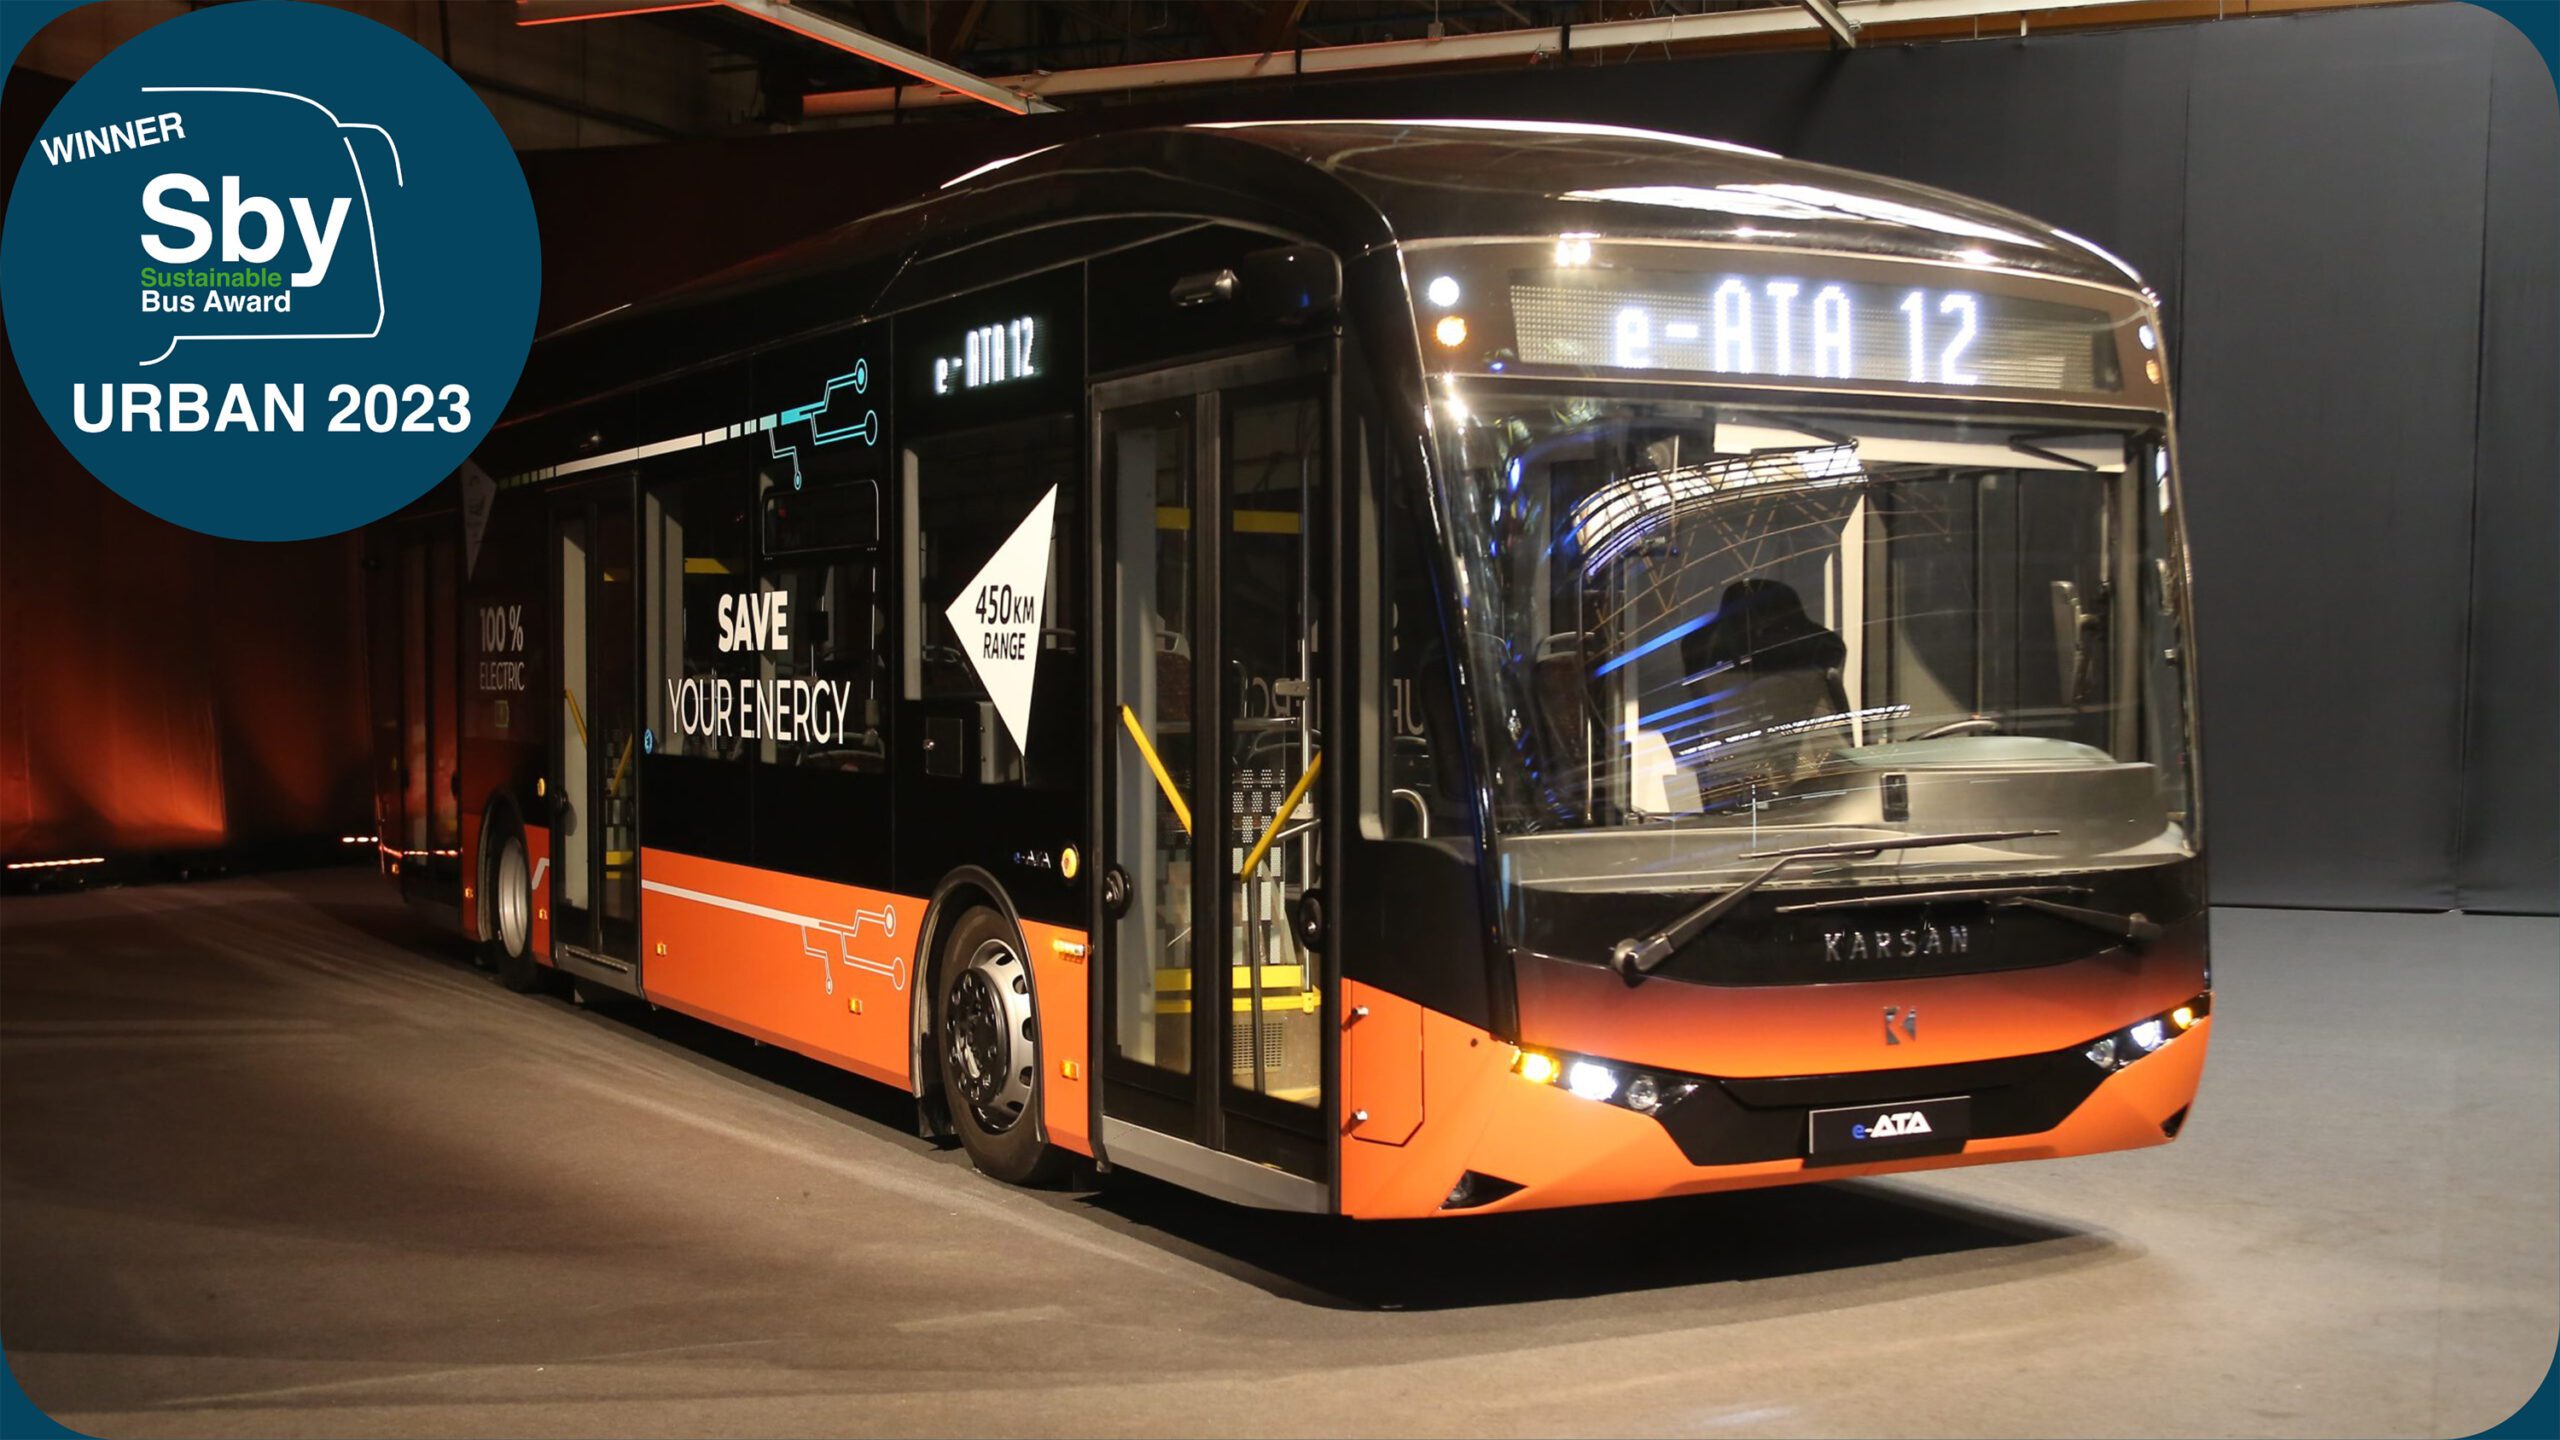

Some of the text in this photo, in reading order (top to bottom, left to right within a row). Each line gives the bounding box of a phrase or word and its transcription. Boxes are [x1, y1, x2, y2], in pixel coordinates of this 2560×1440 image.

[934, 317, 1034, 394] e-ATA 12
[1615, 278, 1978, 386] e-ATA 12
[718, 590, 788, 652] SAVE
[983, 632, 1026, 660] RANGE
[480, 661, 525, 692] ELECTRIC
[668, 678, 851, 745] YOUR ENERGY
[1824, 925, 1968, 961] KARSAN
[1852, 1110, 1933, 1139] e-ATA
